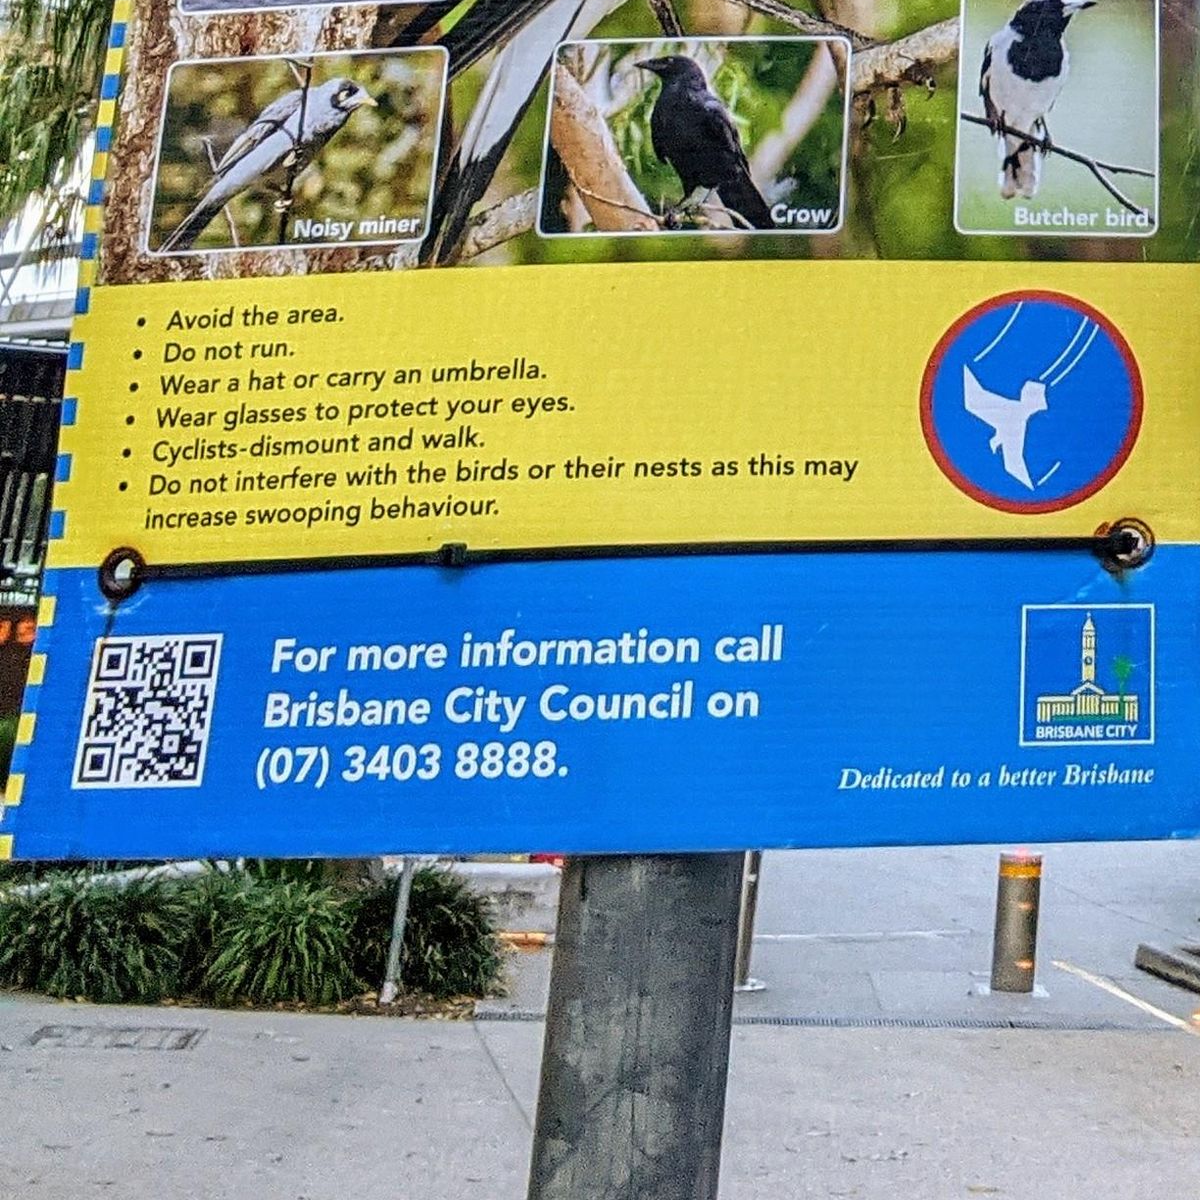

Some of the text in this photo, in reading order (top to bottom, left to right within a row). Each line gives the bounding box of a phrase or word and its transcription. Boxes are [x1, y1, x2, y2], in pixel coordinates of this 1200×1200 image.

[293, 215, 420, 240] Noisy miner
[770, 203, 832, 223] Crow
[1014, 207, 1148, 227] Butcher bird
[166, 305, 345, 331] Avoid the area.
[163, 342, 295, 363] Do not run.
[160, 358, 547, 395] Wear a hat or carry an umbrella.
[157, 396, 576, 431] Wear glasses to protect your eyes.
[153, 426, 485, 468] Cyclists-dismount and walk.
[149, 454, 859, 496] Do not interfere with the birds or their nests as this may
[145, 495, 499, 529] increase swooping behaviour.
[271, 625, 784, 673] For more information call
[264, 680, 759, 732] Brisbane City Council on
[1036, 725, 1138, 739] BRISBANE CITY
[256, 741, 569, 790] (07) 3403 8888.
[838, 763, 1154, 790] Dedicated to a better Brisbane
